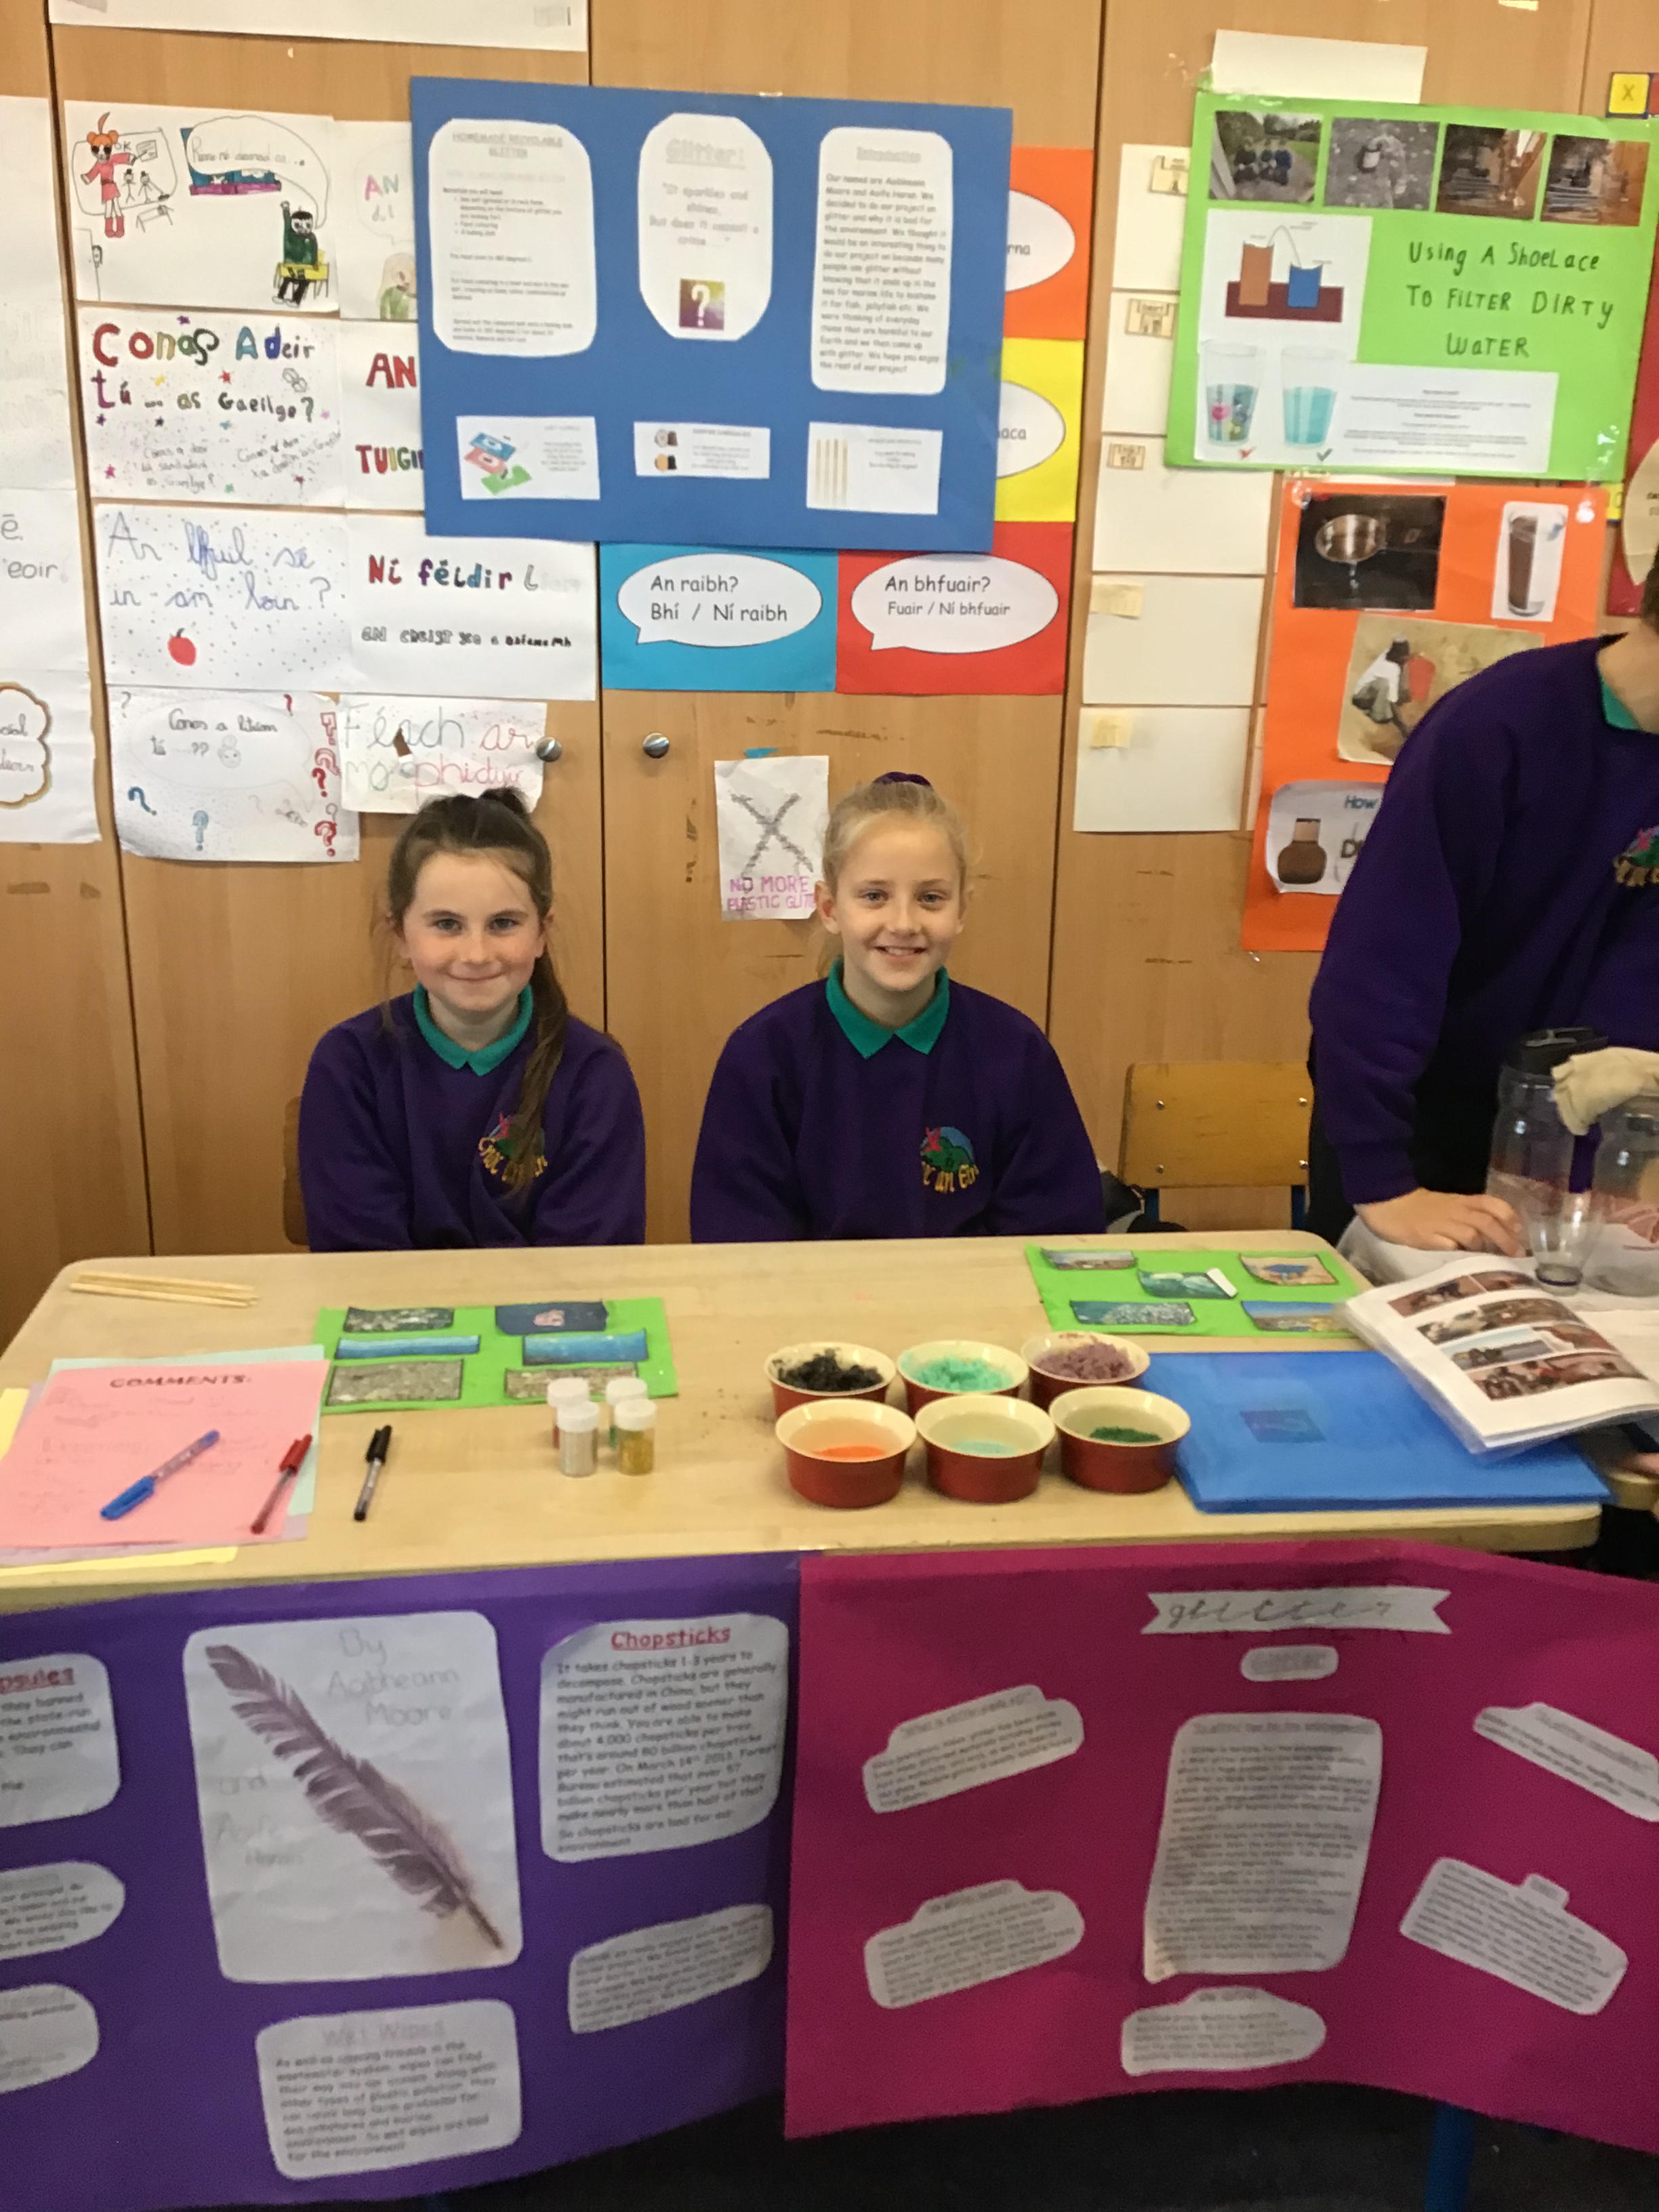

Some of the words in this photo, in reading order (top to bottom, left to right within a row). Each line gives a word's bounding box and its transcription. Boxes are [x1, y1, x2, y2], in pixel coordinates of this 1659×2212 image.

[1410, 241, 1467, 276] Using
[1481, 245, 1495, 265] A
[366, 352, 417, 388] AN
[651, 575, 675, 593] An
[680, 575, 739, 594] raibh?
[885, 575, 909, 593] An
[914, 575, 991, 594] bhfuair?
[651, 602, 680, 621] Bhí
[713, 602, 734, 621] Ní
[739, 602, 788, 621] raibh
[888, 600, 923, 617] Fuair
[939, 600, 956, 617] Ní
[960, 600, 1012, 617] bhfuair
[1345, 794, 1378, 808] How
[730, 877, 754, 894] NO
[760, 875, 809, 893] MORE
[110, 1374, 252, 1388] COMMENTS:
[611, 1627, 731, 1651] Chopsticks
